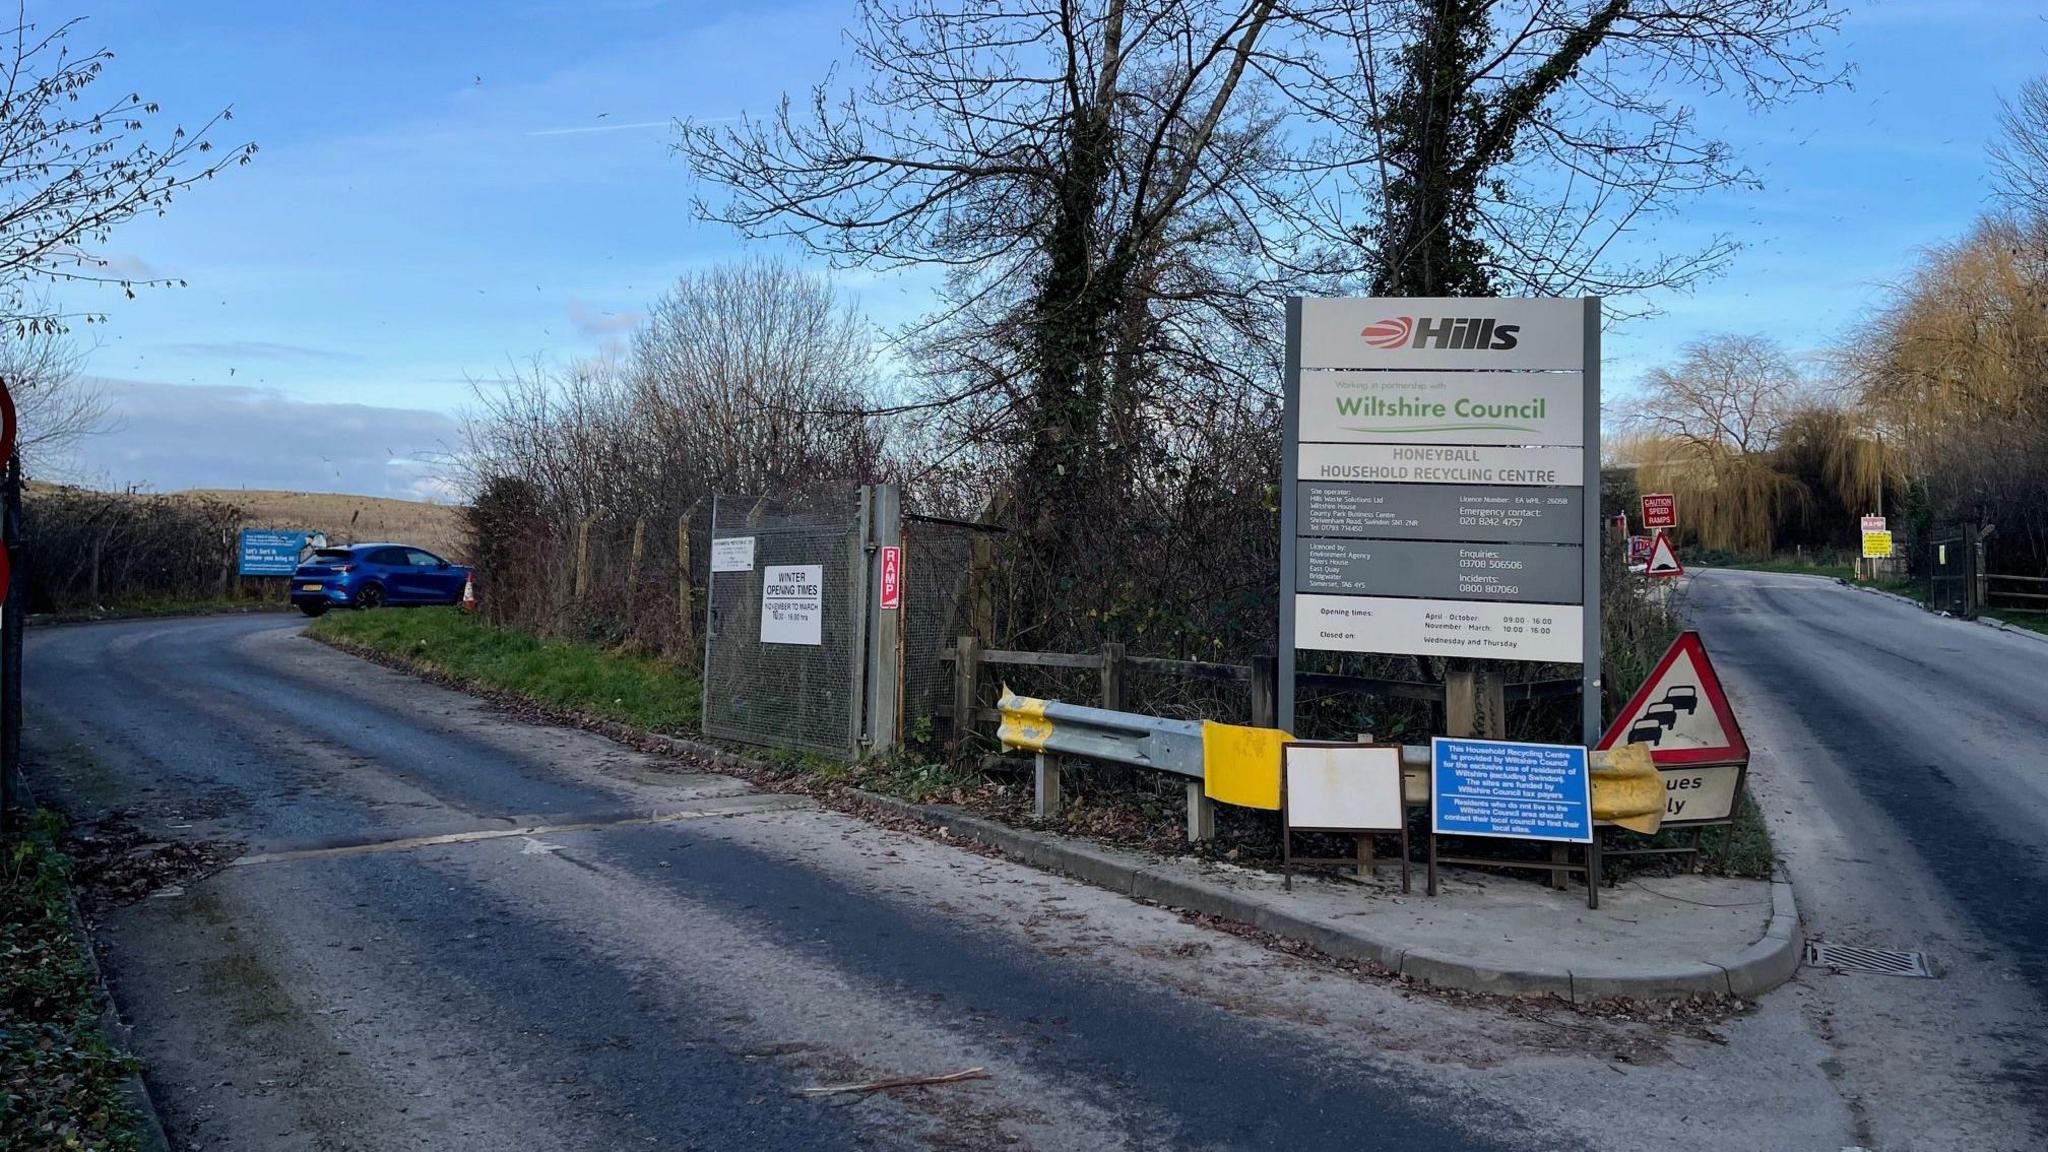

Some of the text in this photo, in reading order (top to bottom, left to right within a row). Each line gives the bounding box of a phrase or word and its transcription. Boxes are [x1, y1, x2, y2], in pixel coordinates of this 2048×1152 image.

[1412, 317, 1521, 350] Hills
[1335, 381, 1446, 391] Working in partnership with
[1336, 396, 1546, 419] Wiltshire Council
[1393, 448, 1480, 462] HONEYBALL
[1321, 465, 1555, 483] HOUSEHOLD RECYCLING CENTRE
[1460, 507, 1505, 517] Emergency
[1460, 517, 1523, 526] 020 8242 4757
[1348, 552, 1371, 560] Agency
[1460, 549, 1499, 559] Enquiries:
[1460, 560, 1522, 569] 03708 506506
[779, 572, 805, 582] WINTER
[886, 551, 895, 596] RAMP
[1460, 574, 1499, 582] Incidents:
[767, 585, 817, 595] OPENING TIMES
[1460, 584, 1518, 594] 0800 807060
[1320, 608, 1349, 616] Opening
[1425, 613, 1442, 621] April
[1425, 622, 1461, 630] November
[1424, 636, 1465, 645] Wednesday
[1484, 640, 1517, 648] Thursday
[1448, 745, 1464, 753] This
[1466, 746, 1505, 755] Household
[1507, 749, 1543, 758] Recycling
[1460, 754, 1492, 762] provided
[1494, 756, 1503, 764] by
[1505, 757, 1538, 765] Wiltshire
[1540, 758, 1568, 766] Council
[1470, 763, 1503, 771] exclusive
[1531, 766, 1566, 775] residents
[1666, 777, 1702, 790] ues
[1458, 786, 1491, 794] Wiltshire
[1493, 788, 1520, 796] Council
[1454, 799, 1489, 807] Residents
[1667, 798, 1686, 815] ly
[1460, 807, 1491, 815] Wiltshire
[1473, 815, 1489, 823] their
[1510, 818, 1536, 826] council
